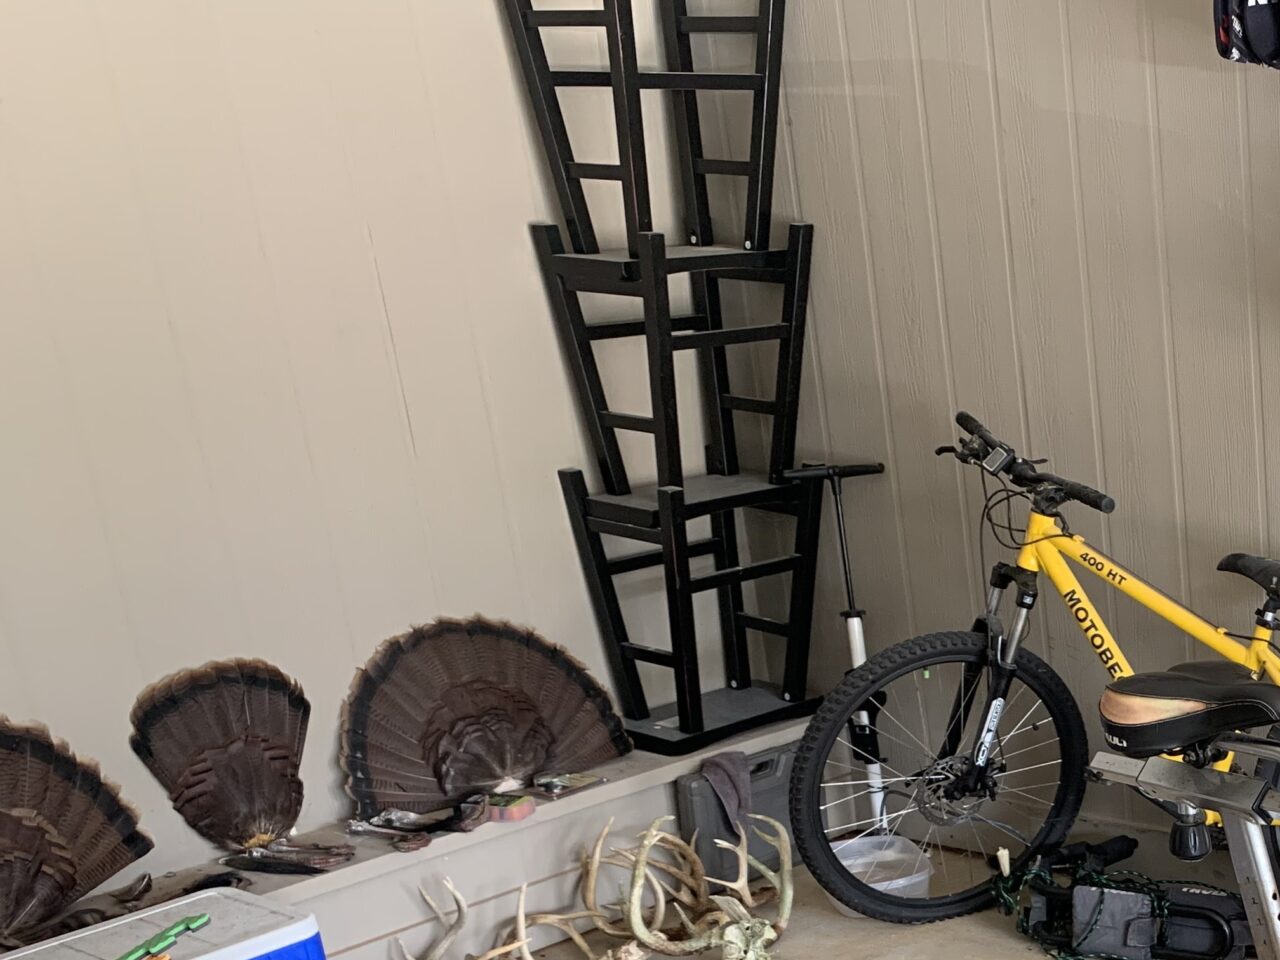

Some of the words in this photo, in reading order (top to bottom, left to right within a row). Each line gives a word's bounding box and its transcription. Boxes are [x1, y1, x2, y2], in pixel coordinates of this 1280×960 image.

[1079, 552, 1105, 572] 400
[1106, 568, 1127, 586] HT
[1063, 588, 1125, 681] MOTOBE
